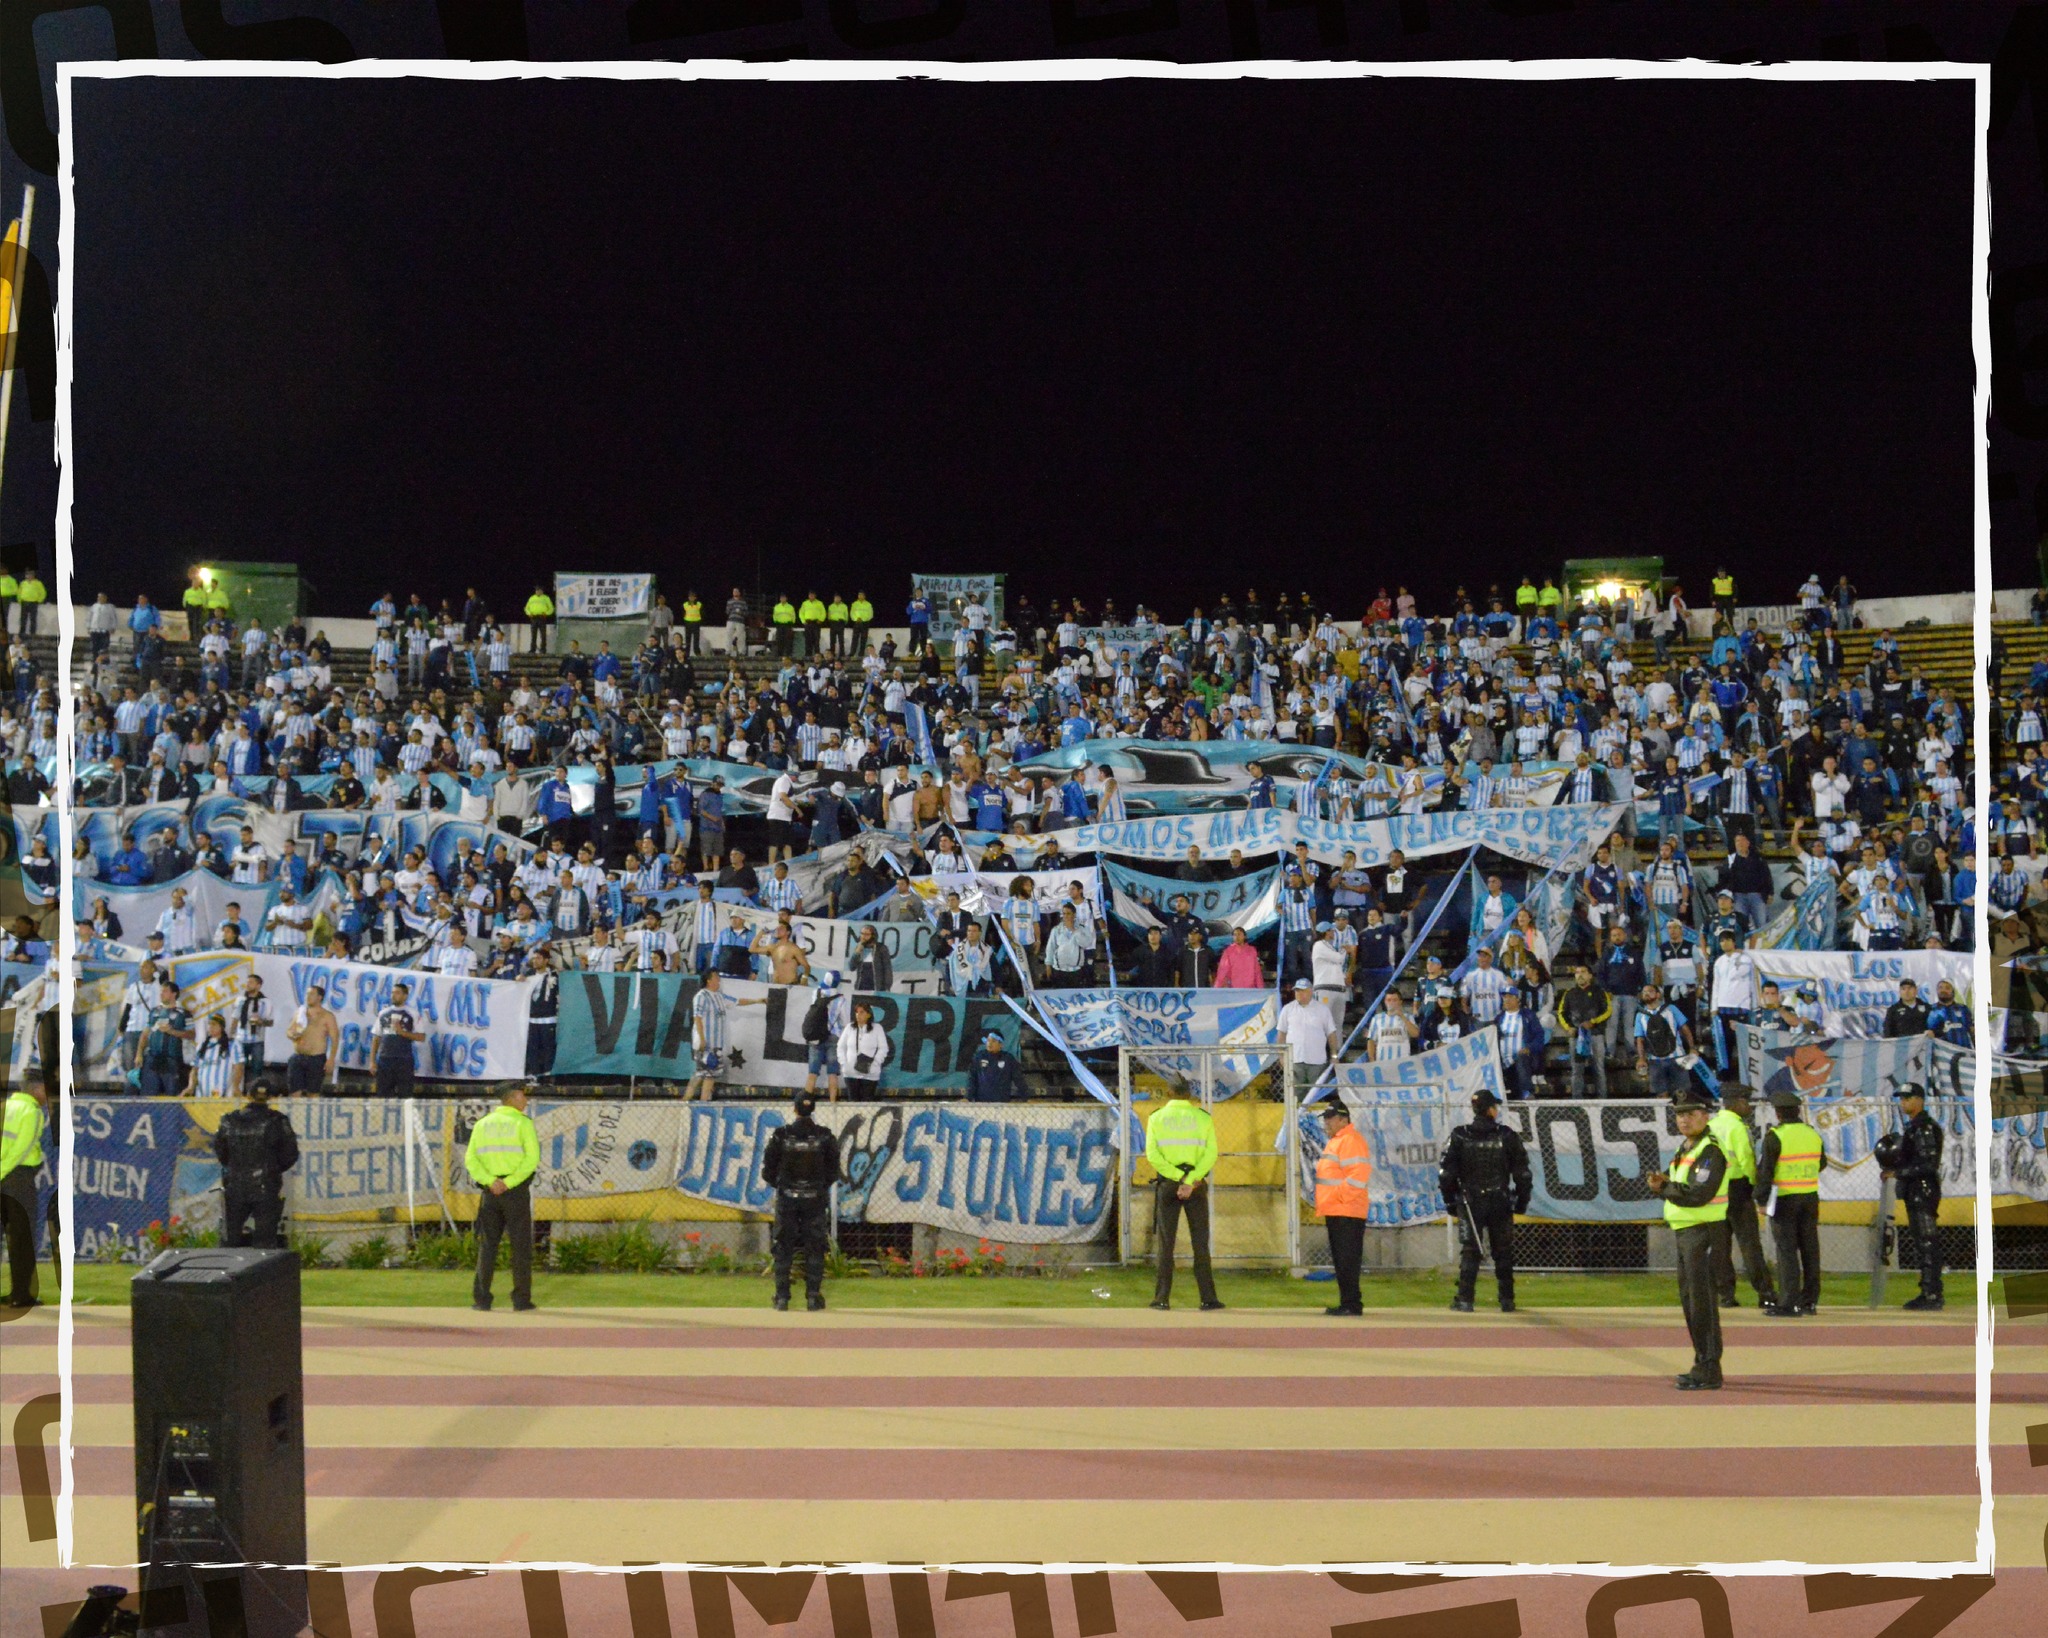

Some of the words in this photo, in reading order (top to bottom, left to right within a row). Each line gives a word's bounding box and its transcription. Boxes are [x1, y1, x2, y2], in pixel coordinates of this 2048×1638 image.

[1076, 816, 1196, 850] SOMOS
[1208, 807, 1282, 849] MAS
[1851, 952, 1904, 981] Los
[290, 961, 350, 1011] VOS
[449, 980, 493, 1029] MI
[1820, 977, 1932, 1012] Misms
[430, 1031, 488, 1078] VOS
[1346, 1031, 1491, 1086] ALEMAN
[126, 1113, 156, 1150] A
